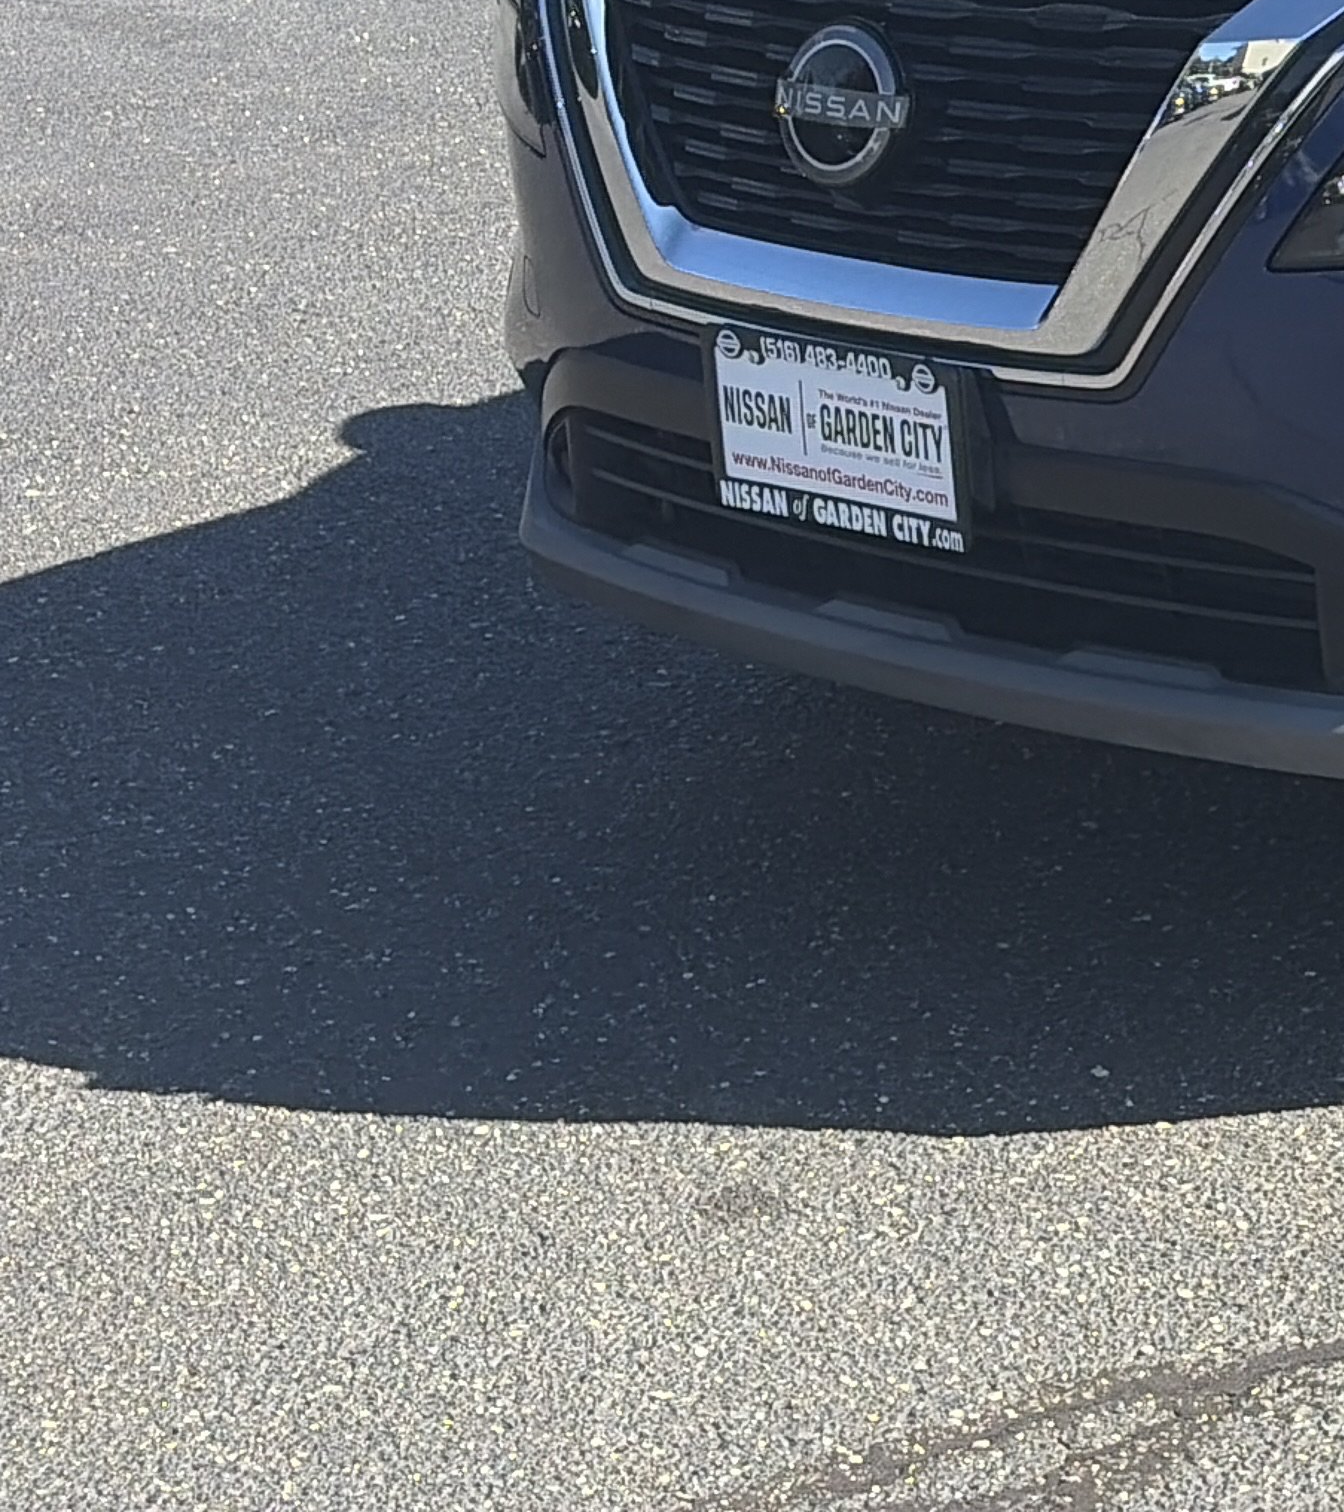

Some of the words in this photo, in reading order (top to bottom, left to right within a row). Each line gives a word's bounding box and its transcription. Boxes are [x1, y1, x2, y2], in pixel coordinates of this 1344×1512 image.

[777, 86, 901, 123] NISSAN
[759, 335, 802, 363] (516)
[805, 344, 892, 380] 483-4400
[722, 384, 793, 434] NISSAN
[820, 403, 896, 454] GARDEN
[900, 418, 943, 463] CITY
[719, 479, 790, 518] NISSAN
[792, 494, 810, 522] of
[812, 498, 889, 537] GARDEN
[732, 451, 950, 508] www.NissanofGardenCity.com
